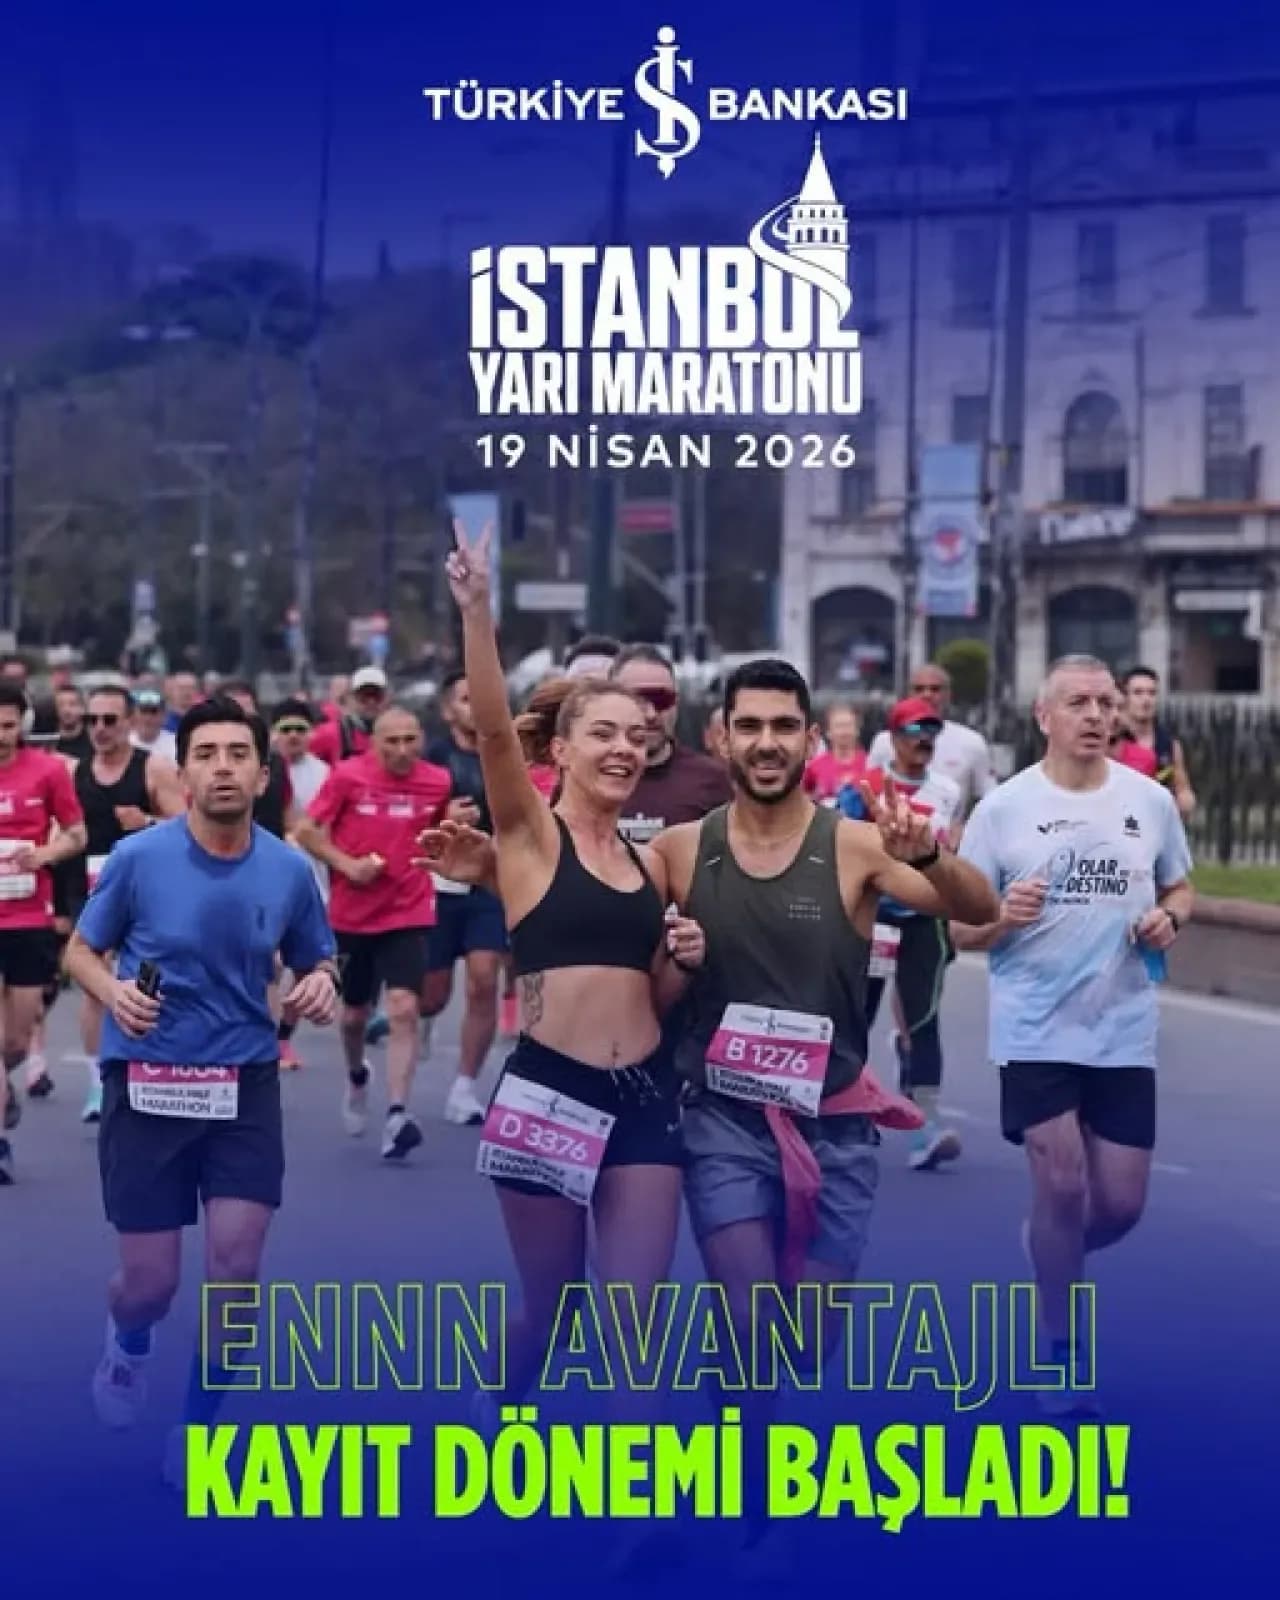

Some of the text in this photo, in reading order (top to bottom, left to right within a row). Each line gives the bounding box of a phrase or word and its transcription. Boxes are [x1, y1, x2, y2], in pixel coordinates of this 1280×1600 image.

[727, 1037, 809, 1075] B 1276
[499, 1112, 521, 1139] D
[524, 1121, 590, 1161] 3376
